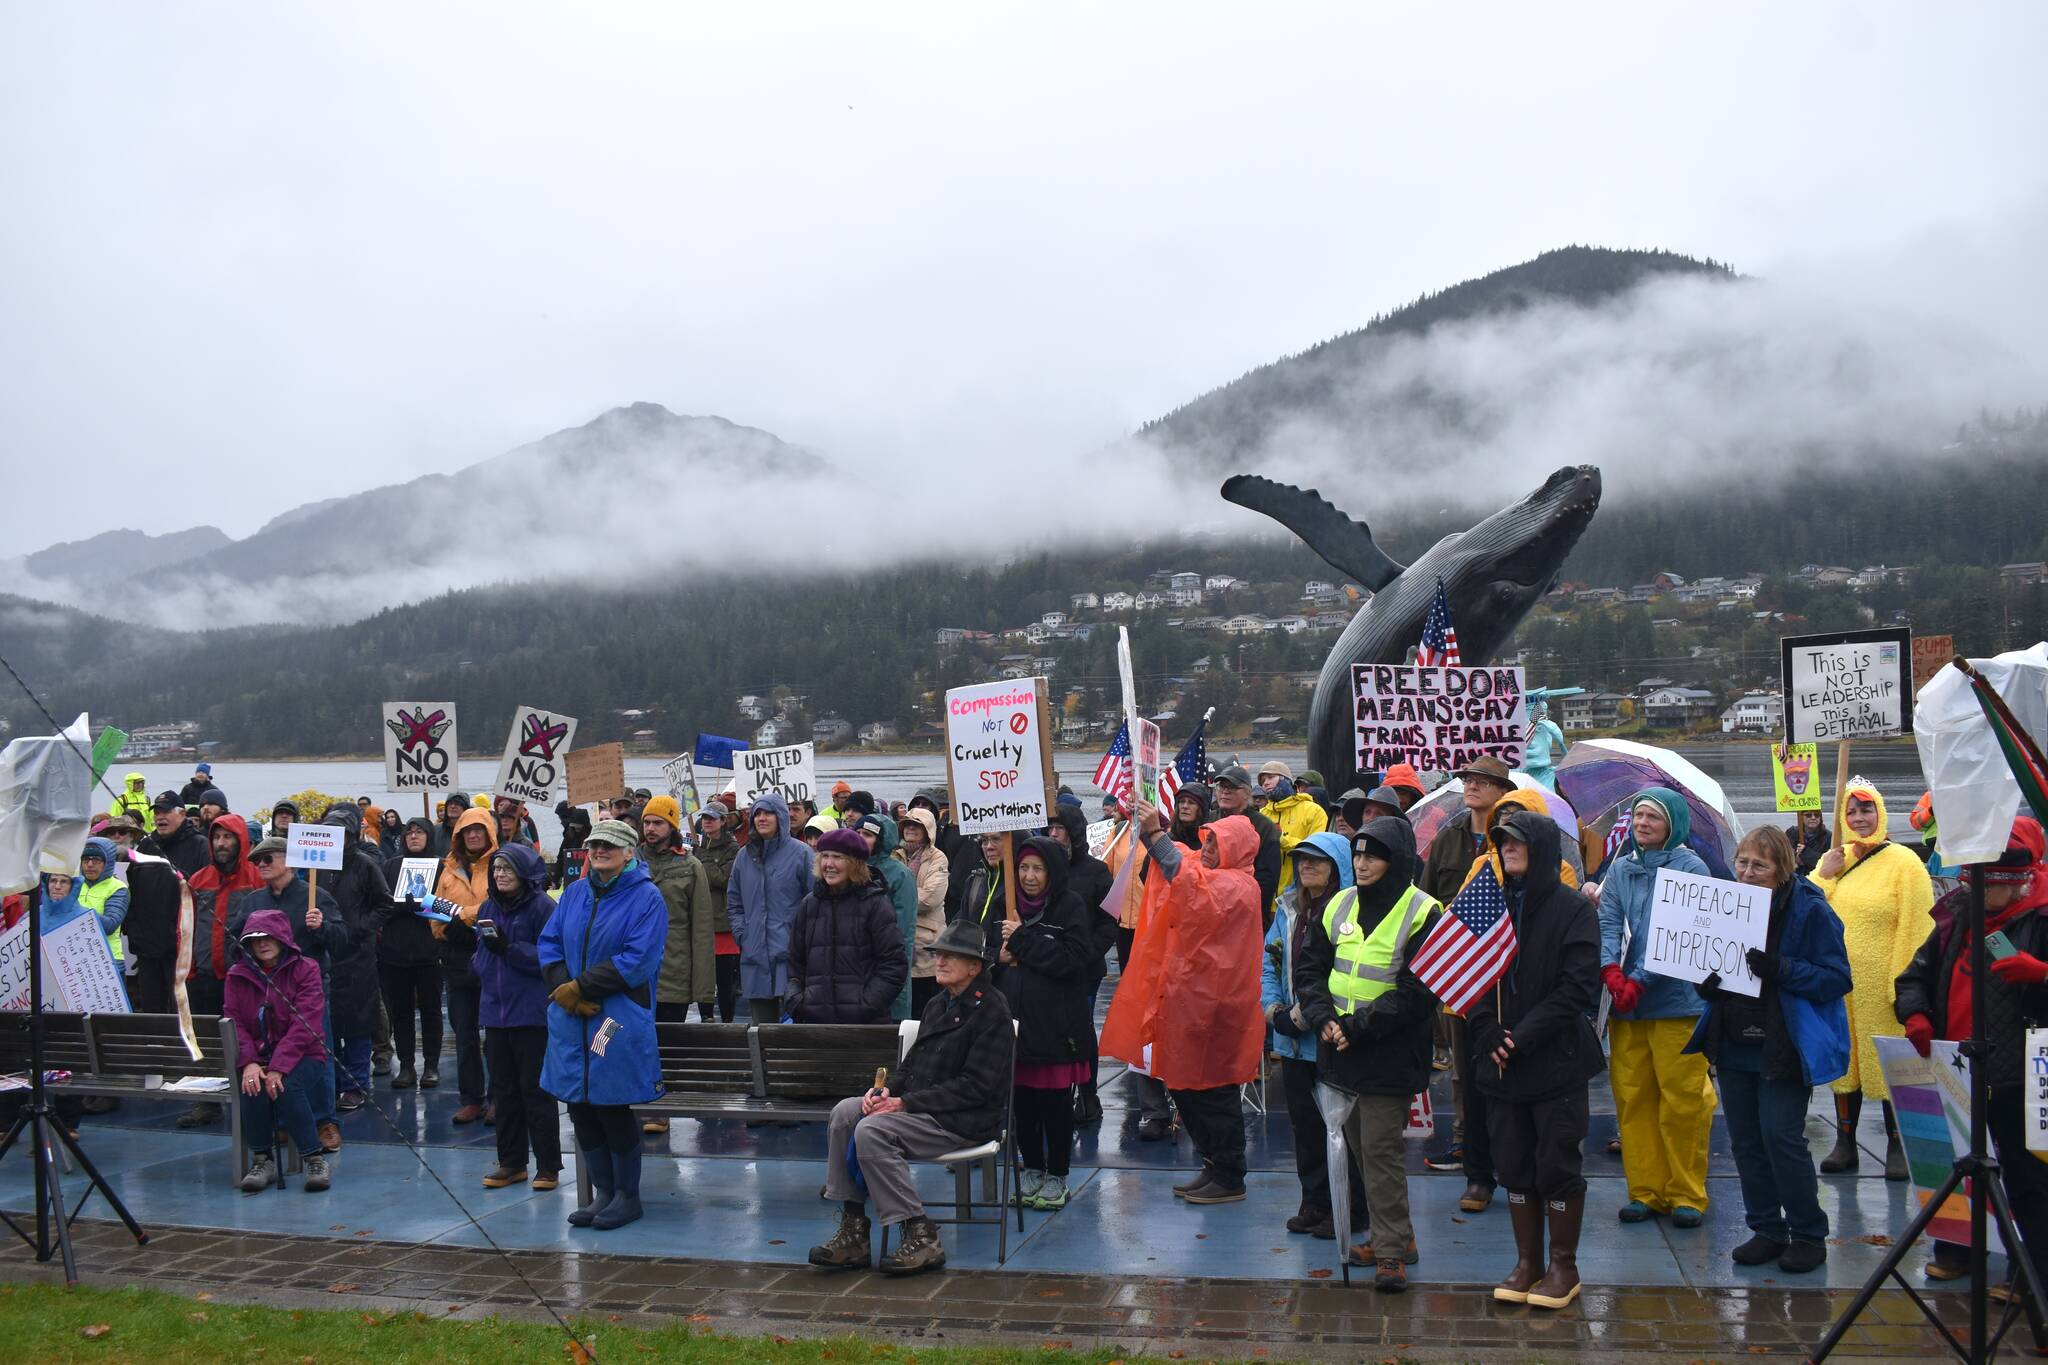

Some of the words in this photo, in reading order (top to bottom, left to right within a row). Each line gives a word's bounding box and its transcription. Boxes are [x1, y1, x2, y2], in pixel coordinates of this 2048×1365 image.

[1912, 638, 1952, 656] RUMP
[1807, 651, 1846, 674] This
[1854, 650, 1871, 669] is
[1353, 665, 1521, 698] FREEDOM
[1826, 669, 1866, 690] NOT
[950, 688, 1034, 717] Compassion
[1465, 696, 1520, 722] GAY
[1858, 702, 1870, 714] is
[982, 719, 1005, 734] NOT
[1357, 724, 1427, 747] TRANS
[1435, 724, 1524, 745] FEMALE
[1814, 712, 1892, 738] BETRAYAL
[396, 747, 449, 774] NO
[745, 749, 802, 771] UNITED
[954, 739, 1023, 767] Cruelty
[396, 774, 449, 789] KINGS
[508, 757, 555, 788] NO
[756, 767, 787, 789] WE
[978, 770, 1019, 791] STOP
[504, 781, 549, 802] KINGS
[962, 802, 1042, 823] Deportations
[297, 839, 334, 847] CRUSHED
[303, 849, 326, 862] ICE
[1662, 879, 1752, 923] IMPEACH
[1693, 915, 1712, 927] AND
[1653, 927, 1754, 982] IMPRISON
[57, 945, 84, 1013] Constitutio
